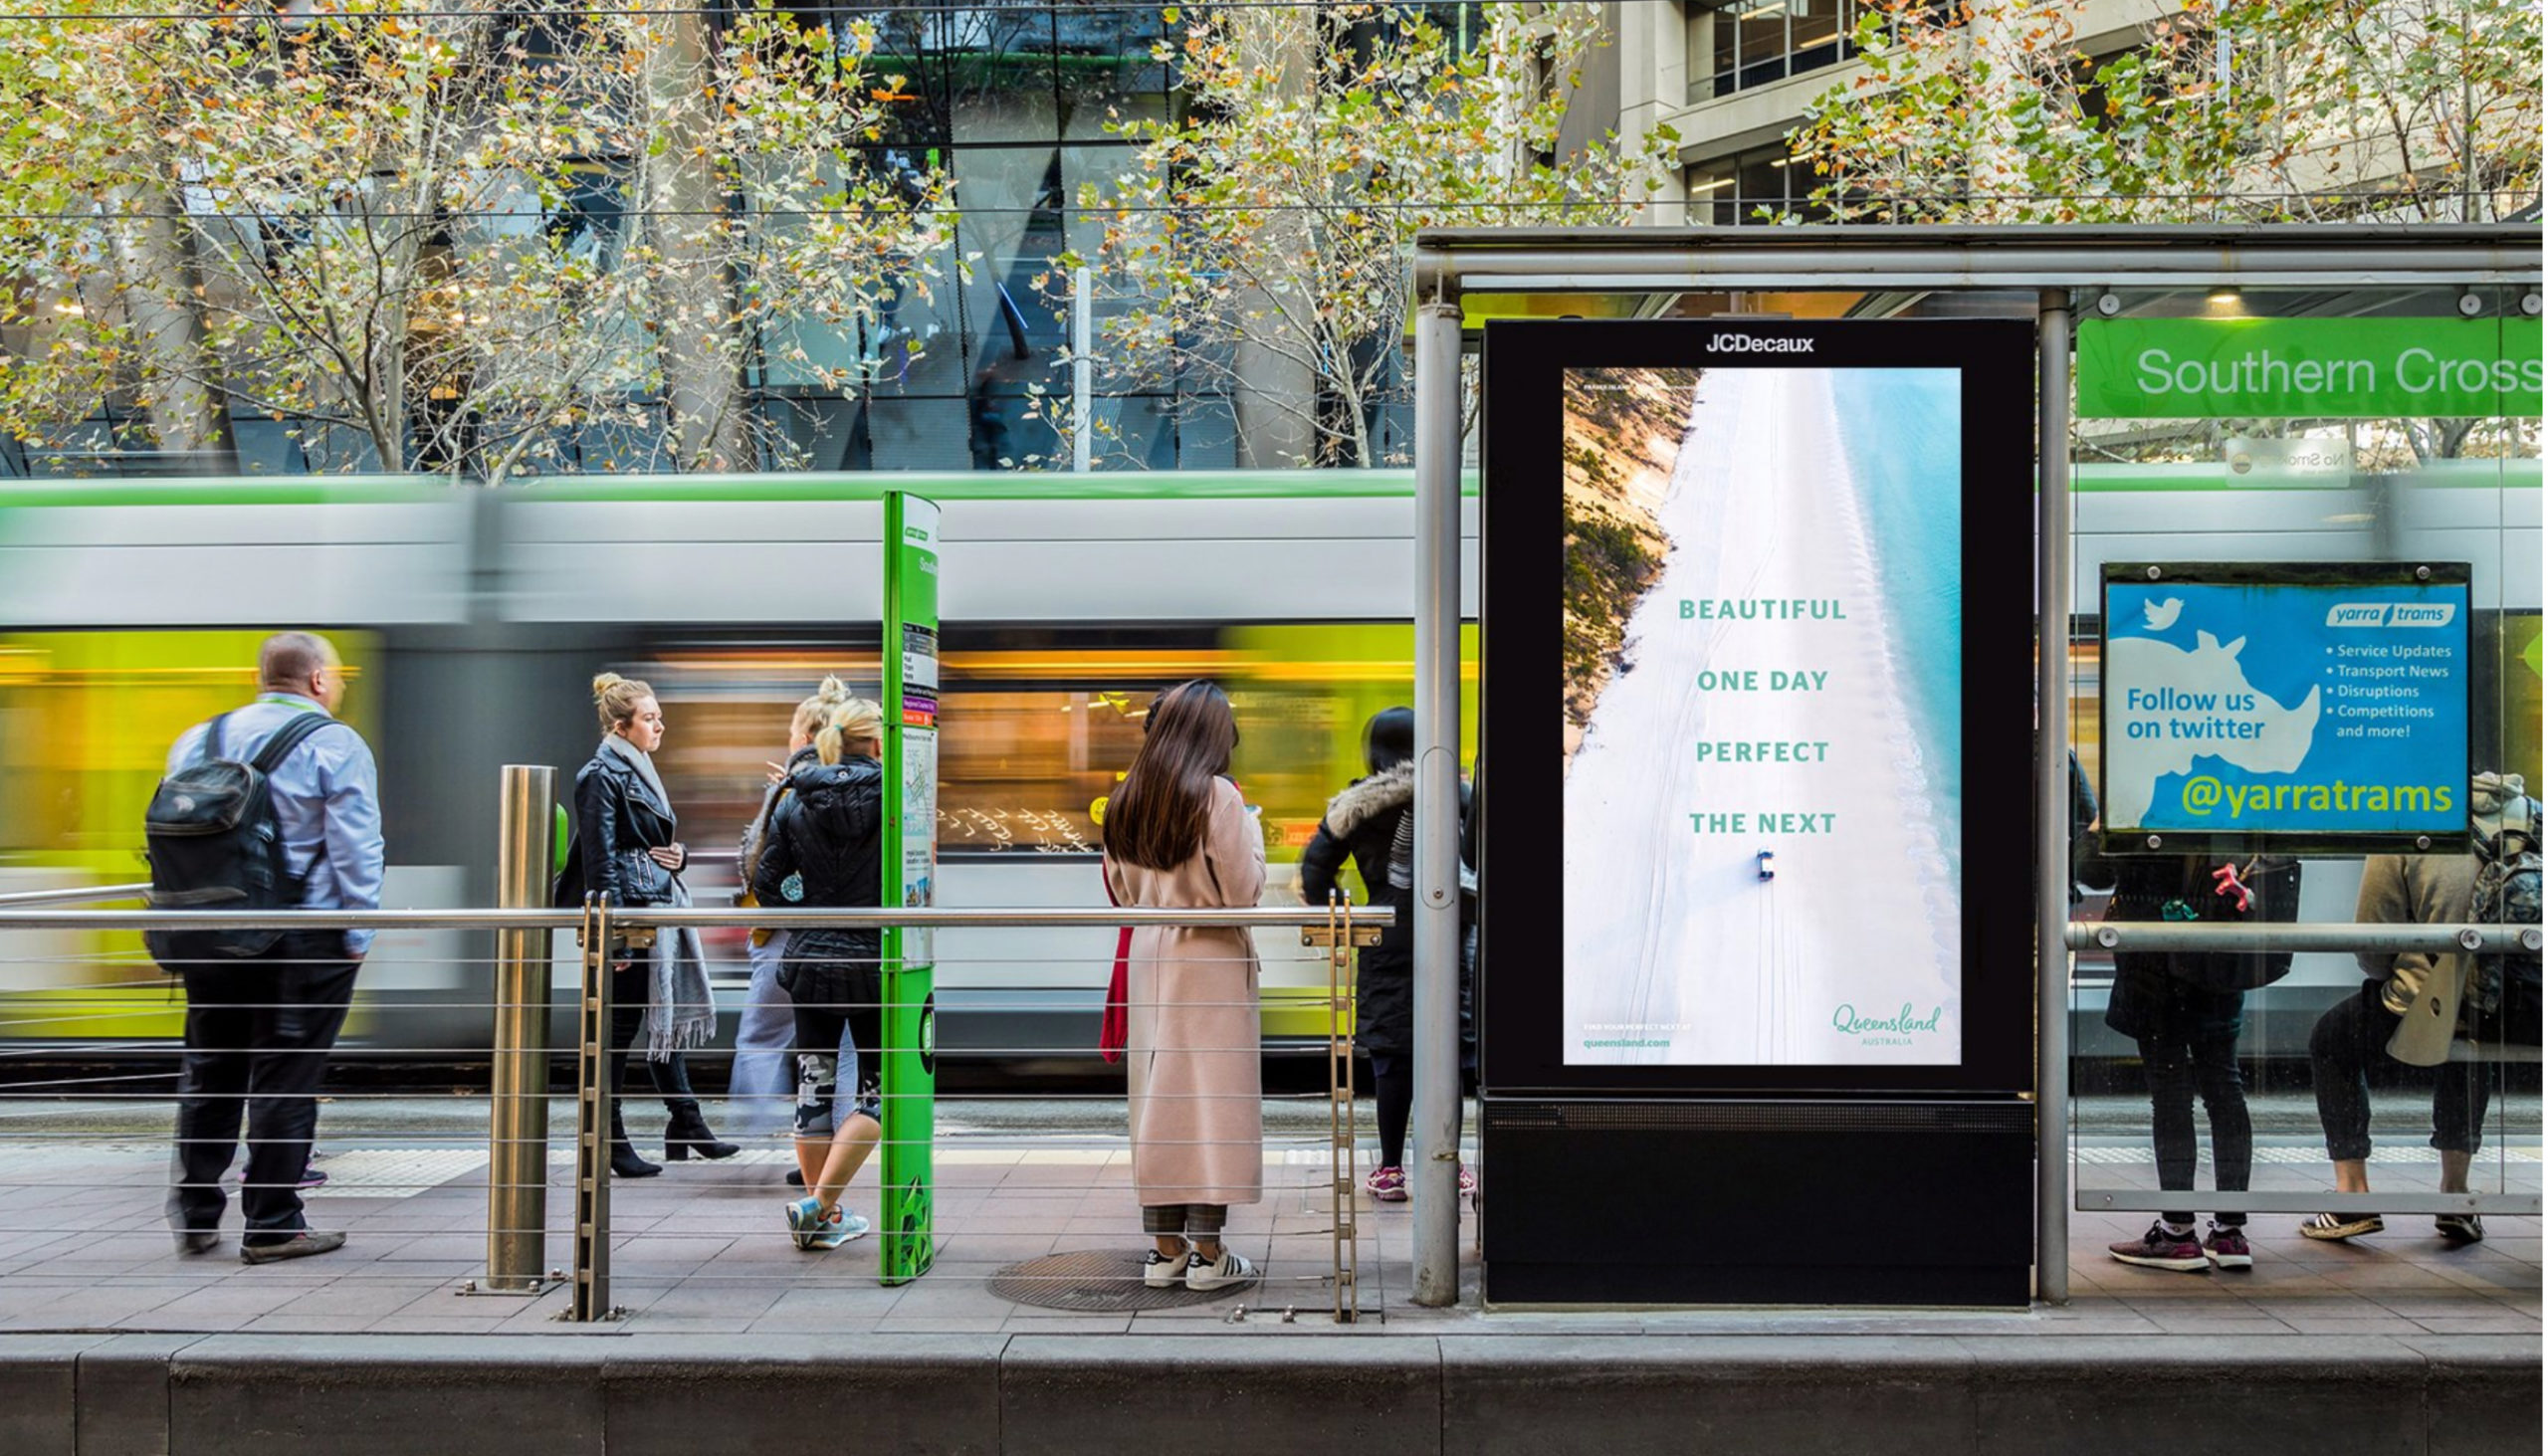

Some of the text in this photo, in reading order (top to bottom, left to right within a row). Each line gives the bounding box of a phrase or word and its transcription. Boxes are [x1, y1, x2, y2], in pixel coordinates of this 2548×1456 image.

[1706, 333, 1814, 353] JCDecaux
[2137, 346, 2542, 394] Southern Cross
[1679, 599, 1847, 620] BEAUTIFUL
[2336, 607, 2444, 624] yarra trams
[2337, 644, 2452, 660] Service Updates
[1697, 670, 1828, 692] ONE DAY
[2337, 664, 2449, 680] Transport News
[2127, 687, 2255, 712] Follow us
[2337, 685, 2420, 700] Disruptions
[2337, 705, 2435, 720] Competitions
[2126, 716, 2266, 739] on twitter
[2336, 725, 2411, 737] and more!
[1696, 741, 1829, 762] PERFECT
[2182, 775, 2452, 819] @yarratrams
[1689, 813, 1836, 834] THE NEXT
[1832, 1001, 1942, 1035] Queensland
[1584, 1038, 1670, 1050] queensland.com
[1861, 1037, 1913, 1046] AUSTRALIA
